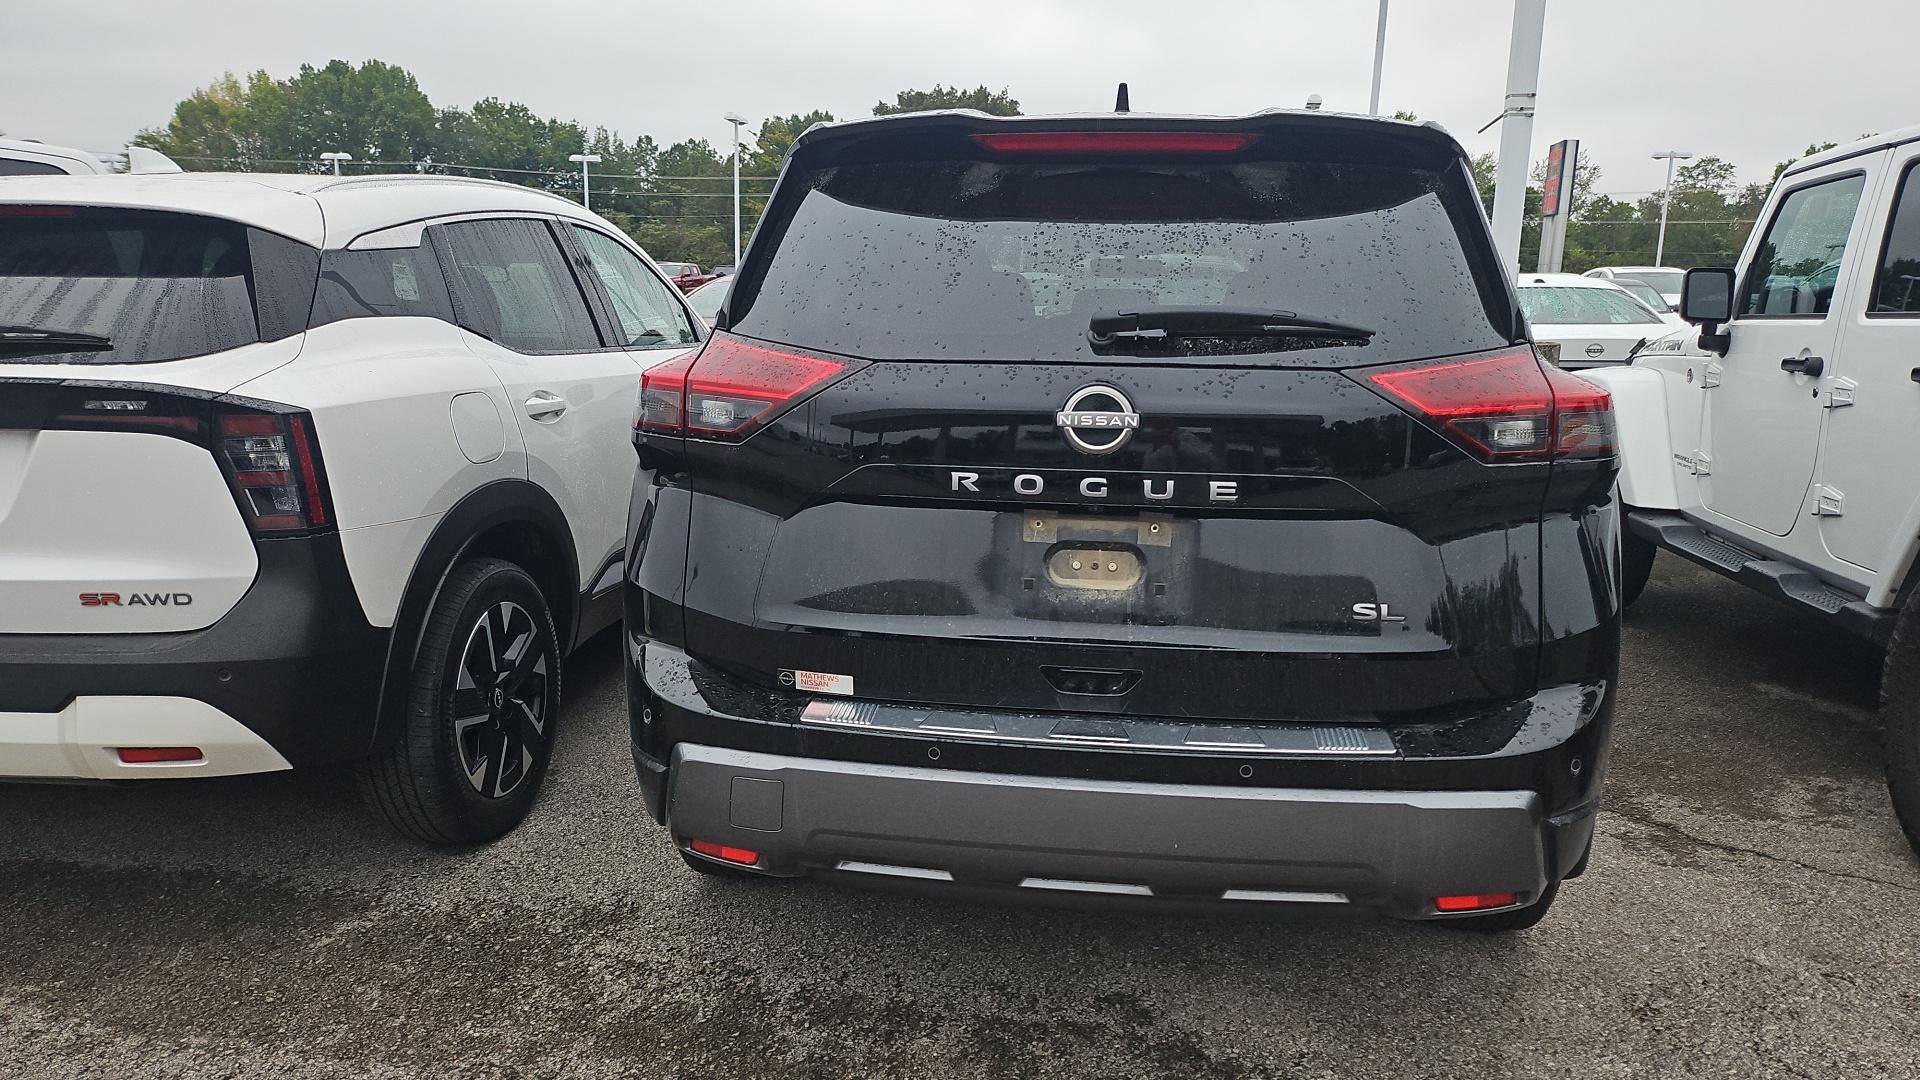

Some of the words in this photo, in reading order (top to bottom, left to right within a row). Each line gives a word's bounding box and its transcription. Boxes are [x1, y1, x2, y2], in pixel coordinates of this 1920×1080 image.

[1057, 413, 1138, 428] NISSAN
[950, 471, 1239, 501] ROGUE
[79, 593, 123, 606] SR
[128, 593, 193, 606] AWD
[1352, 603, 1406, 621] SL
[800, 672, 840, 683] MATHEWS
[800, 679, 829, 687] NISSAN
